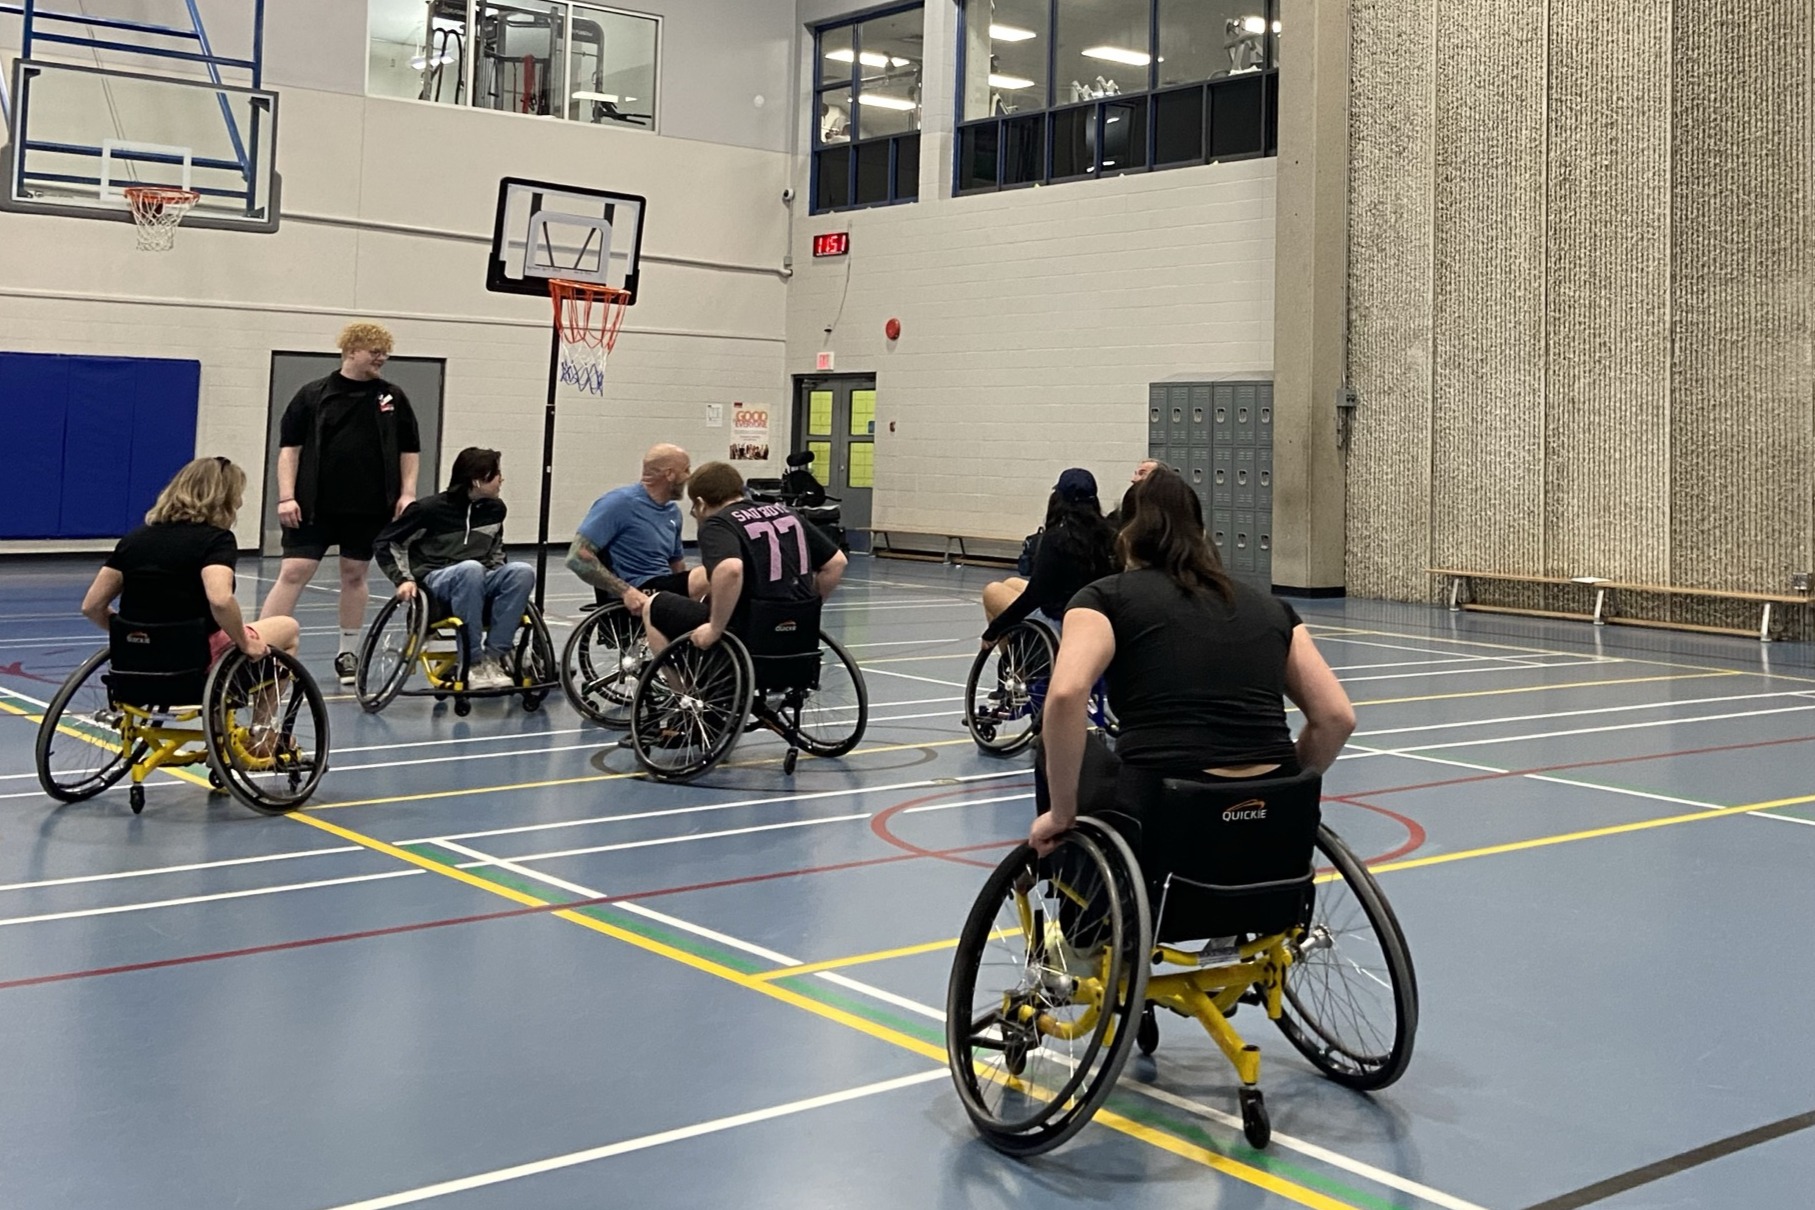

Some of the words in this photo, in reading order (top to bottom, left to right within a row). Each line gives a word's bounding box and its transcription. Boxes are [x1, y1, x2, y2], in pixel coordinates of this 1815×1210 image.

[736, 411, 768, 421] GOOD
[731, 507, 762, 522] SAD
[743, 515, 808, 581] 77
[1222, 809, 1267, 822] QUICKIE
